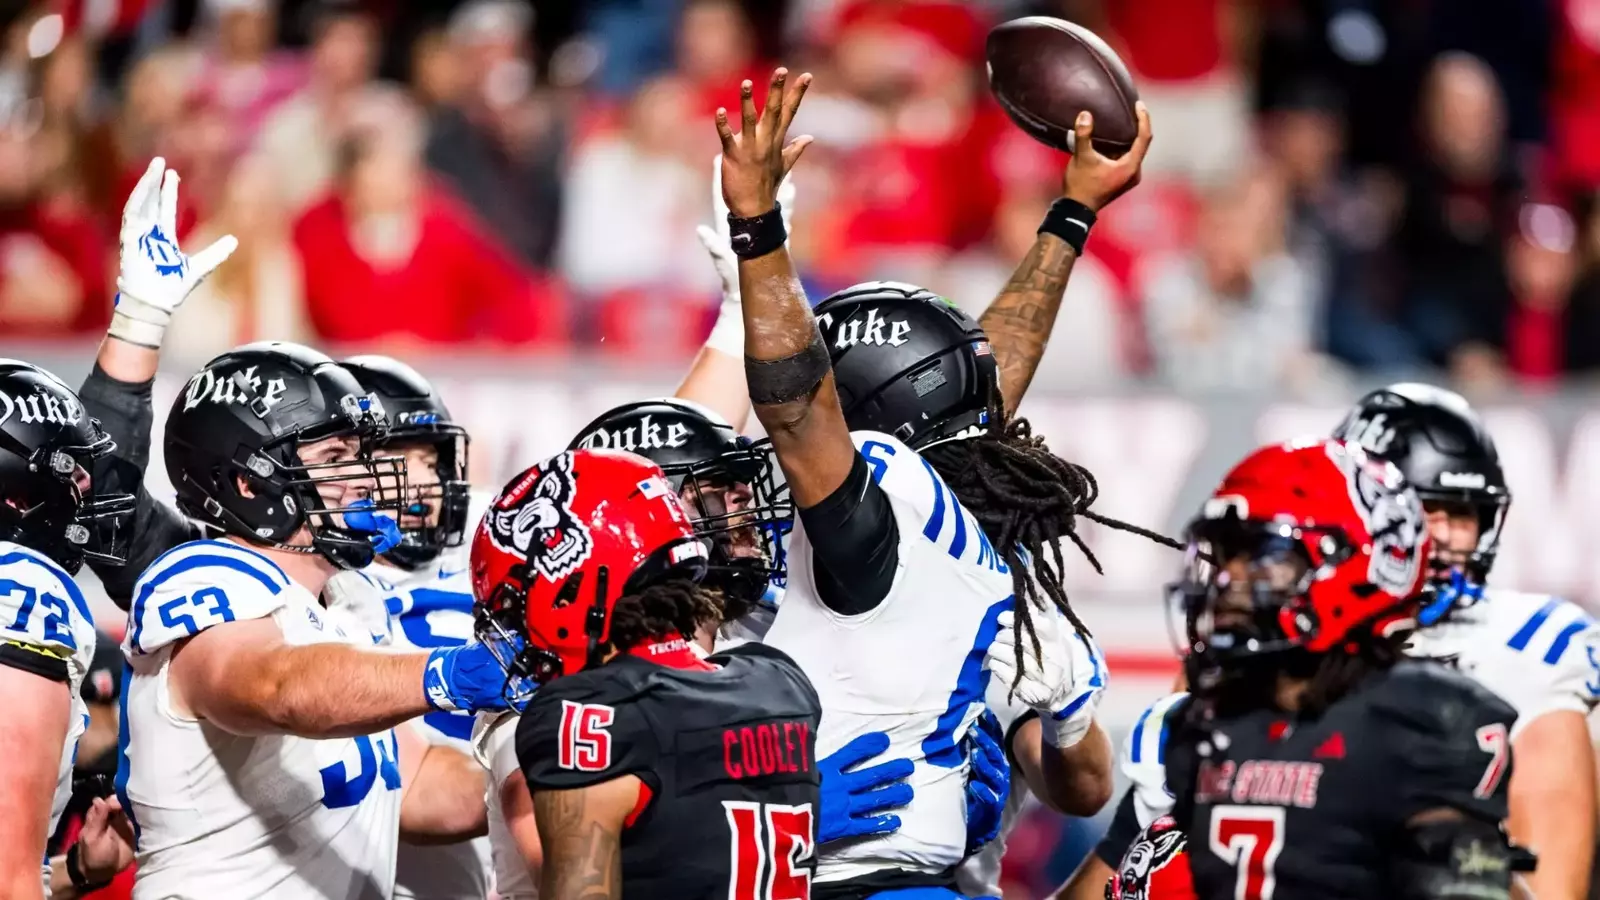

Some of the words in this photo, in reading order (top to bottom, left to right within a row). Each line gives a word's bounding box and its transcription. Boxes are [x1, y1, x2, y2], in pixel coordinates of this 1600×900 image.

[815, 307, 912, 350] uke
[183, 365, 287, 413] Duke
[577, 414, 689, 451] Duke
[0, 578, 78, 651] 72
[158, 586, 236, 636] 53
[558, 700, 615, 772] 15
[722, 721, 809, 780] COOLEY
[1472, 722, 1509, 800] 7
[1209, 803, 1287, 900] 7
